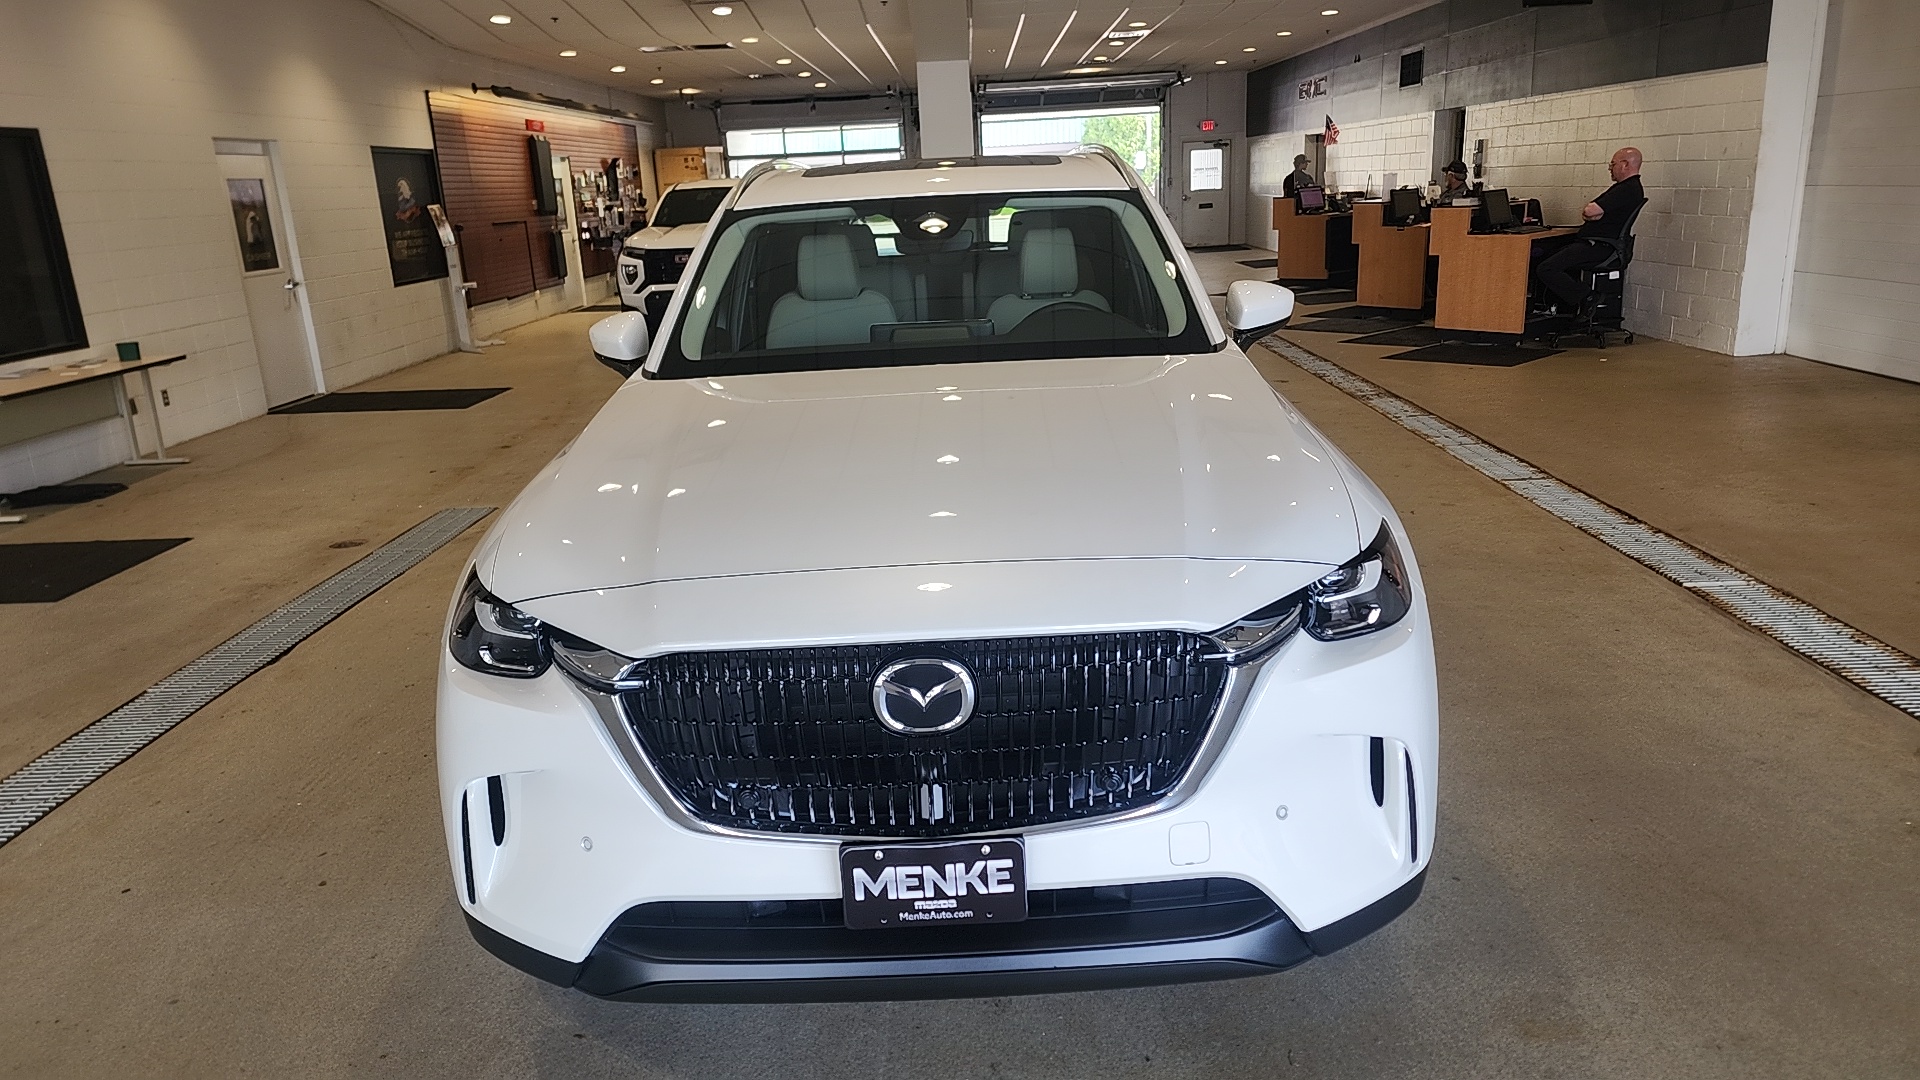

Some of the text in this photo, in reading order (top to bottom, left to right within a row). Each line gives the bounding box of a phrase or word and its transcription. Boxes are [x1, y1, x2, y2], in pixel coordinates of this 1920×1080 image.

[1202, 120, 1215, 131] EXIT
[852, 858, 1015, 901] MENKE
[899, 910, 974, 921] MenkeAuto.com
